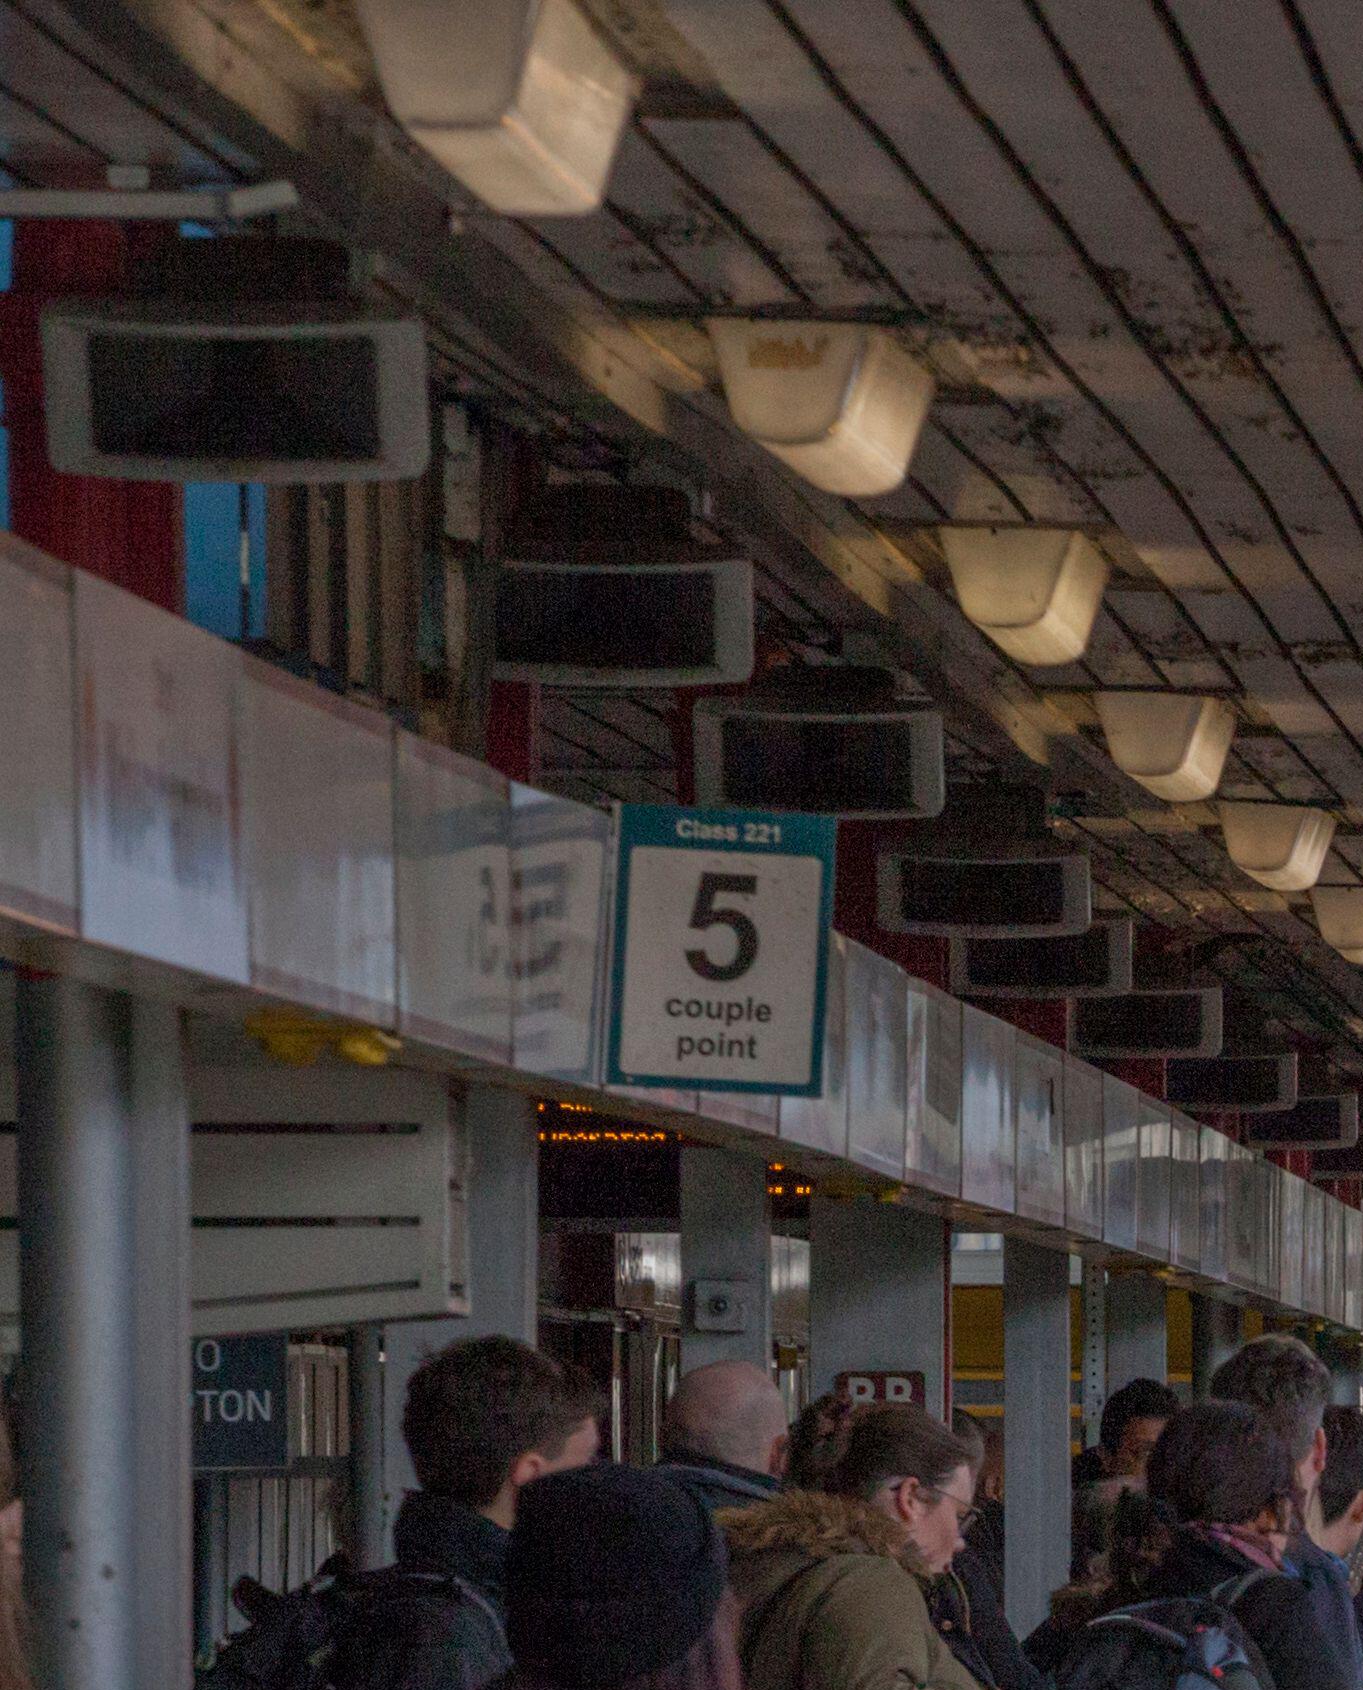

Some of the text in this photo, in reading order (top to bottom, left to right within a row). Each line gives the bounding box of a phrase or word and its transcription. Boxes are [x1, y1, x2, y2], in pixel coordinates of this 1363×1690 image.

[676, 819, 782, 844] Class 221
[684, 872, 760, 982] 5
[665, 997, 772, 1025] couple
[677, 1034, 758, 1061] point
[195, 1340, 221, 1372] O
[197, 1390, 273, 1423] TON
